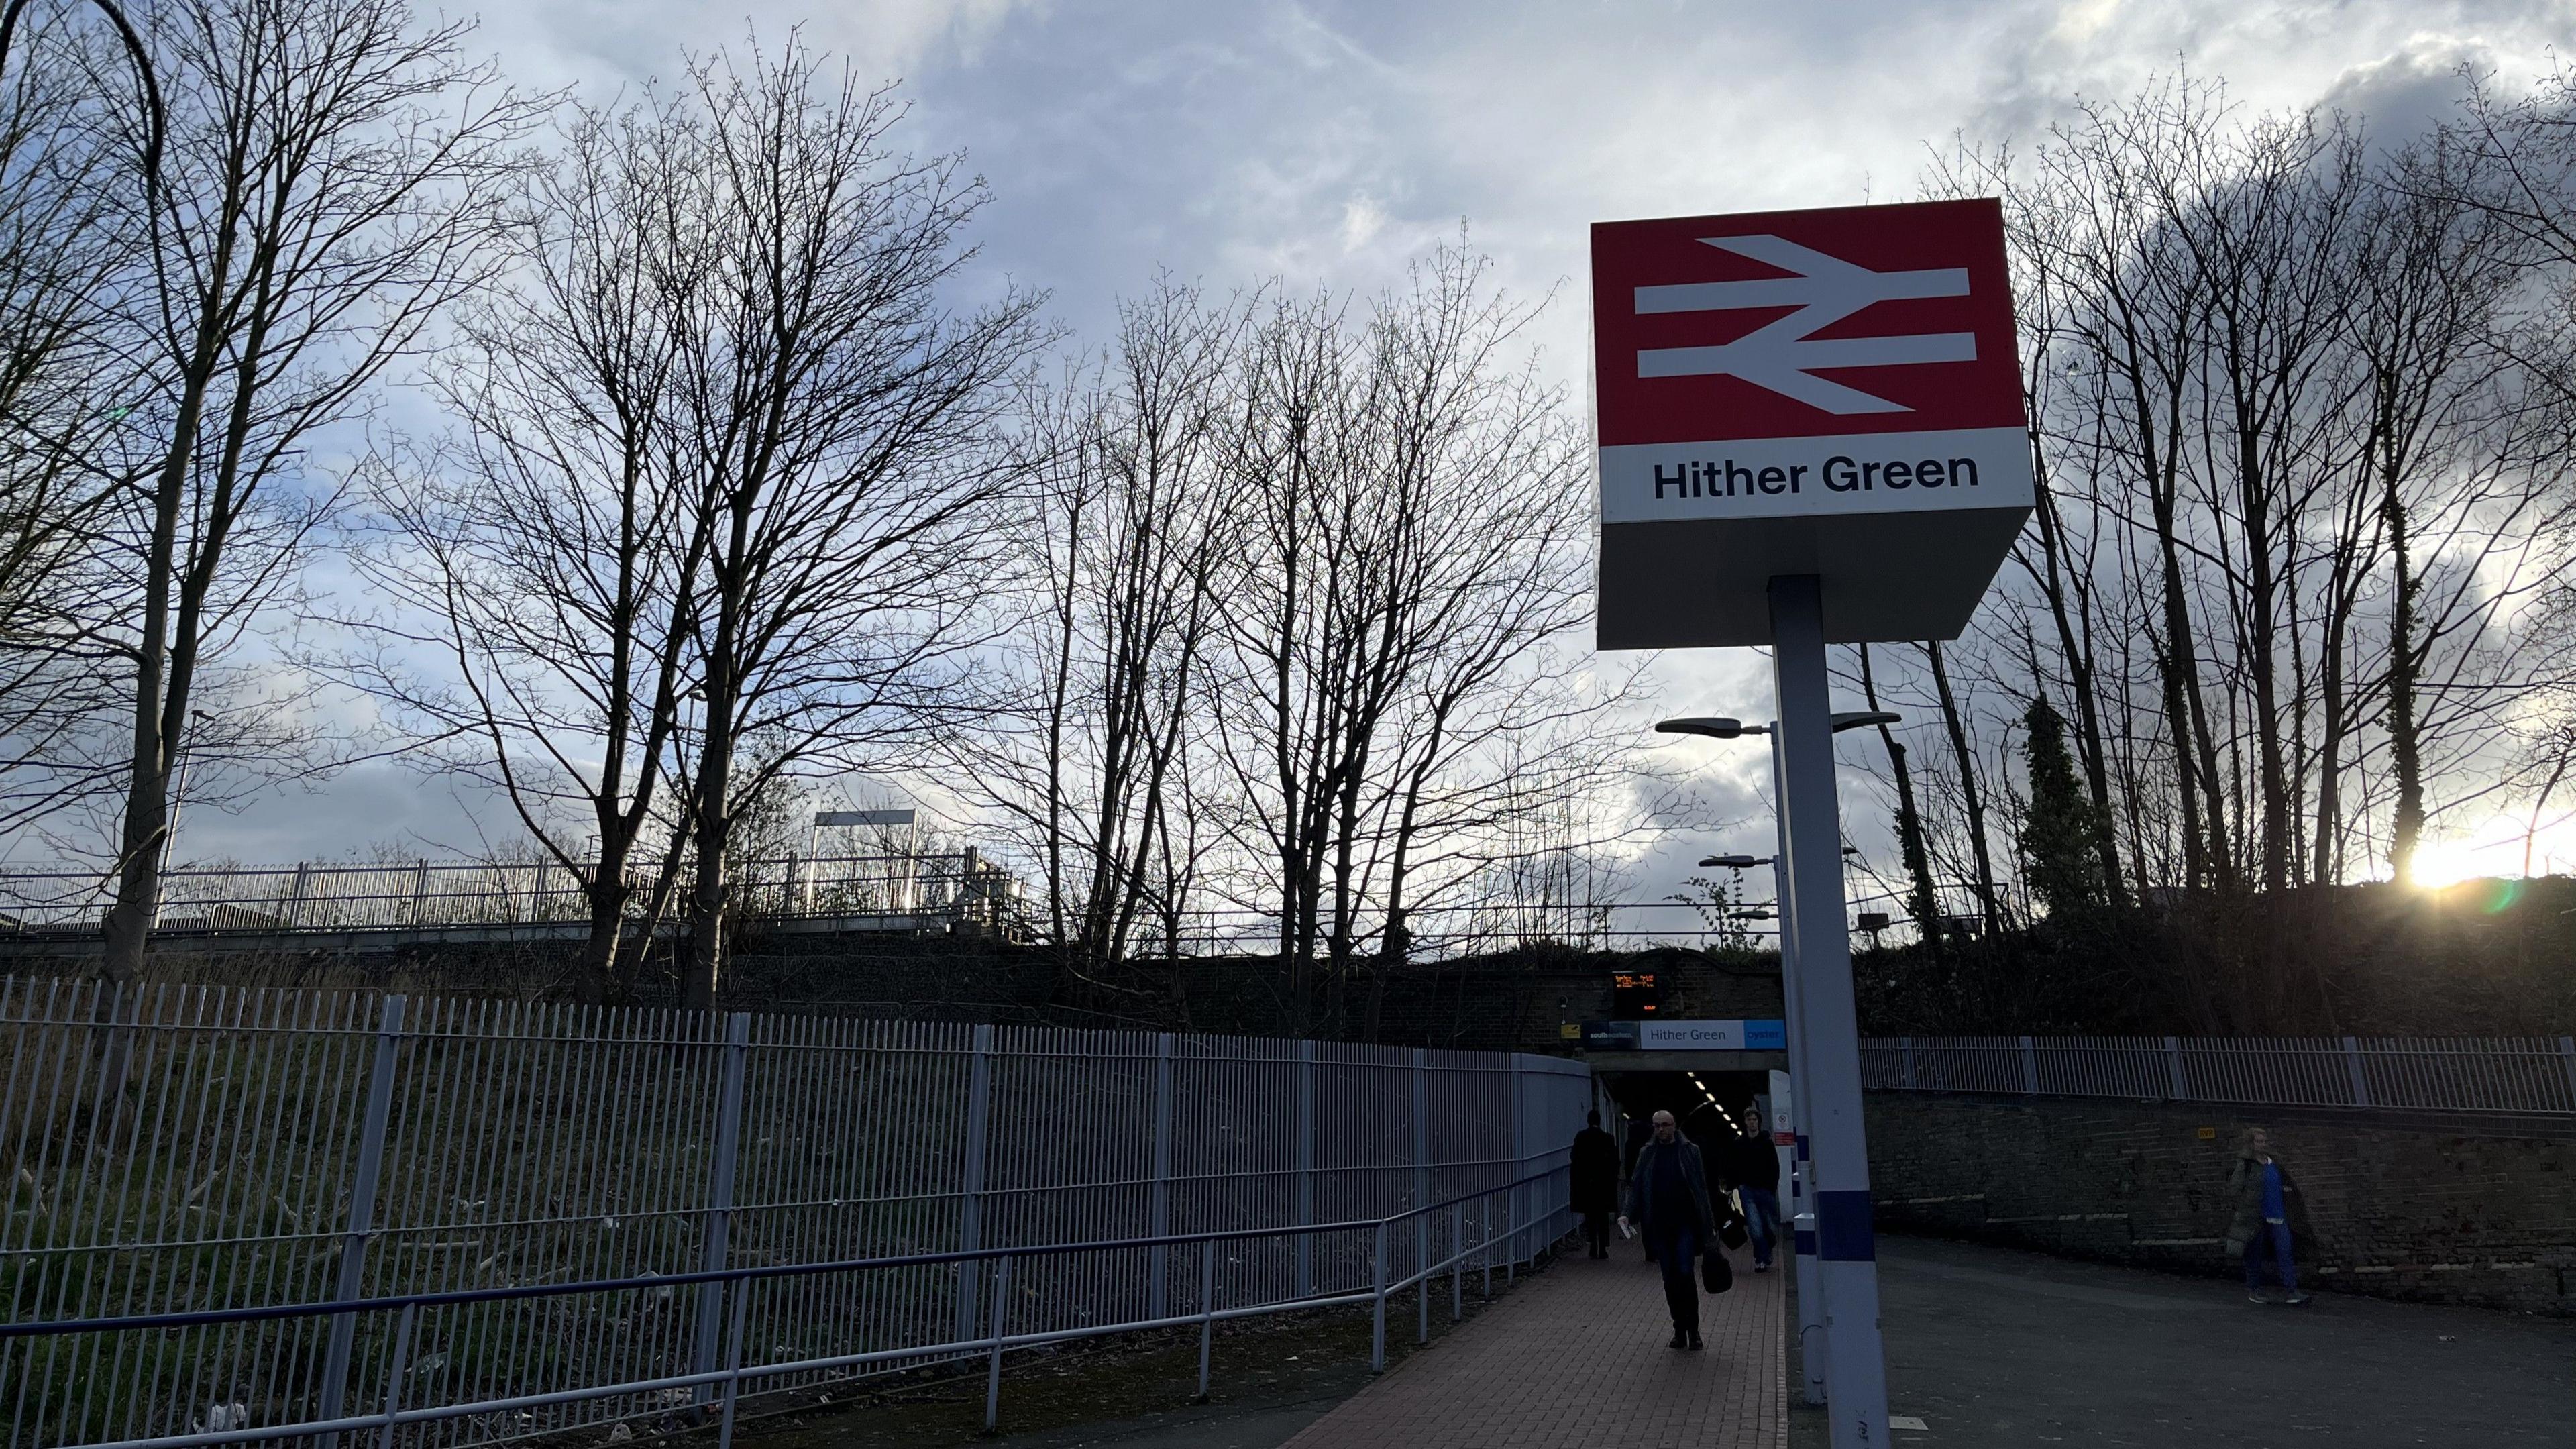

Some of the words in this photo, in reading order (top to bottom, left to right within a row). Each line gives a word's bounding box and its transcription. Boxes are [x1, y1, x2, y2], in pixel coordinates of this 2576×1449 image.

[1654, 460, 1808, 498] Hither
[1822, 456, 1978, 492] Green
[1650, 1029, 1686, 1040] Hither
[1690, 1029, 1726, 1040] Green
[1747, 1030, 1780, 1040] oyster
